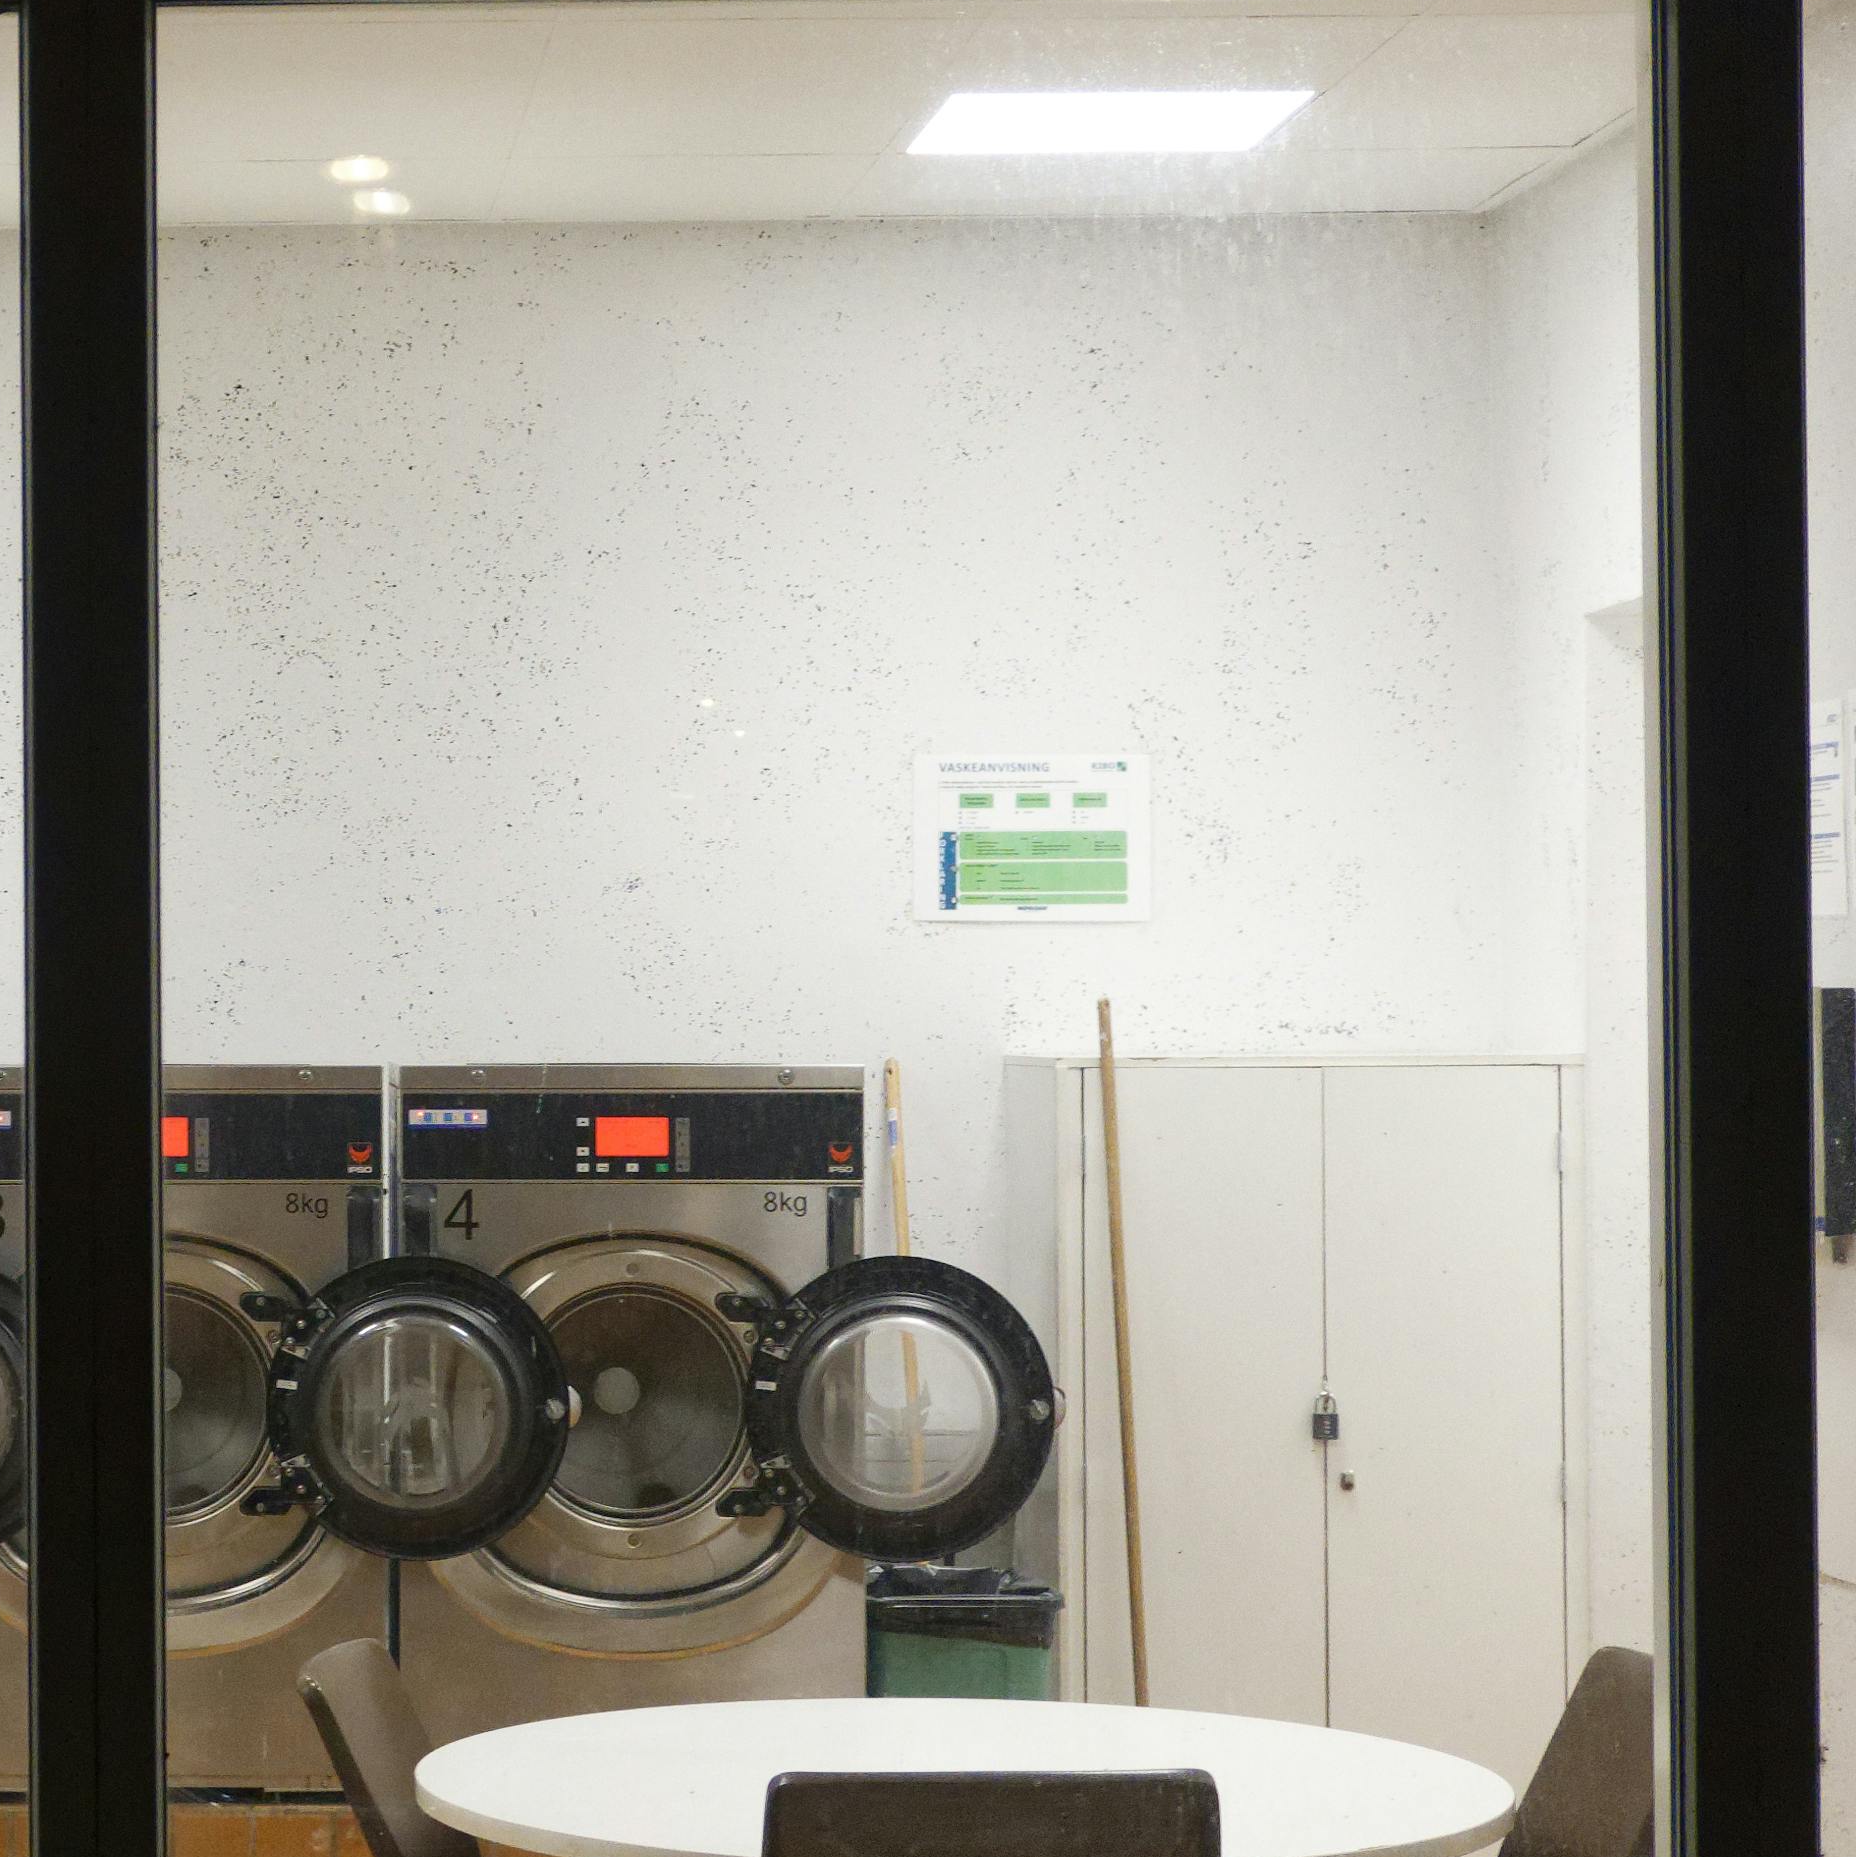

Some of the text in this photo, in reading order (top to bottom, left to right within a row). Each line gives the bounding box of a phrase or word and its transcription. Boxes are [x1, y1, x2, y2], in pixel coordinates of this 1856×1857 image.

[939, 762, 1050, 772] VASKEANVISNING
[285, 1193, 329, 1219] 8kg
[442, 1188, 480, 1241] 4
[763, 1191, 808, 1217] 8kg
